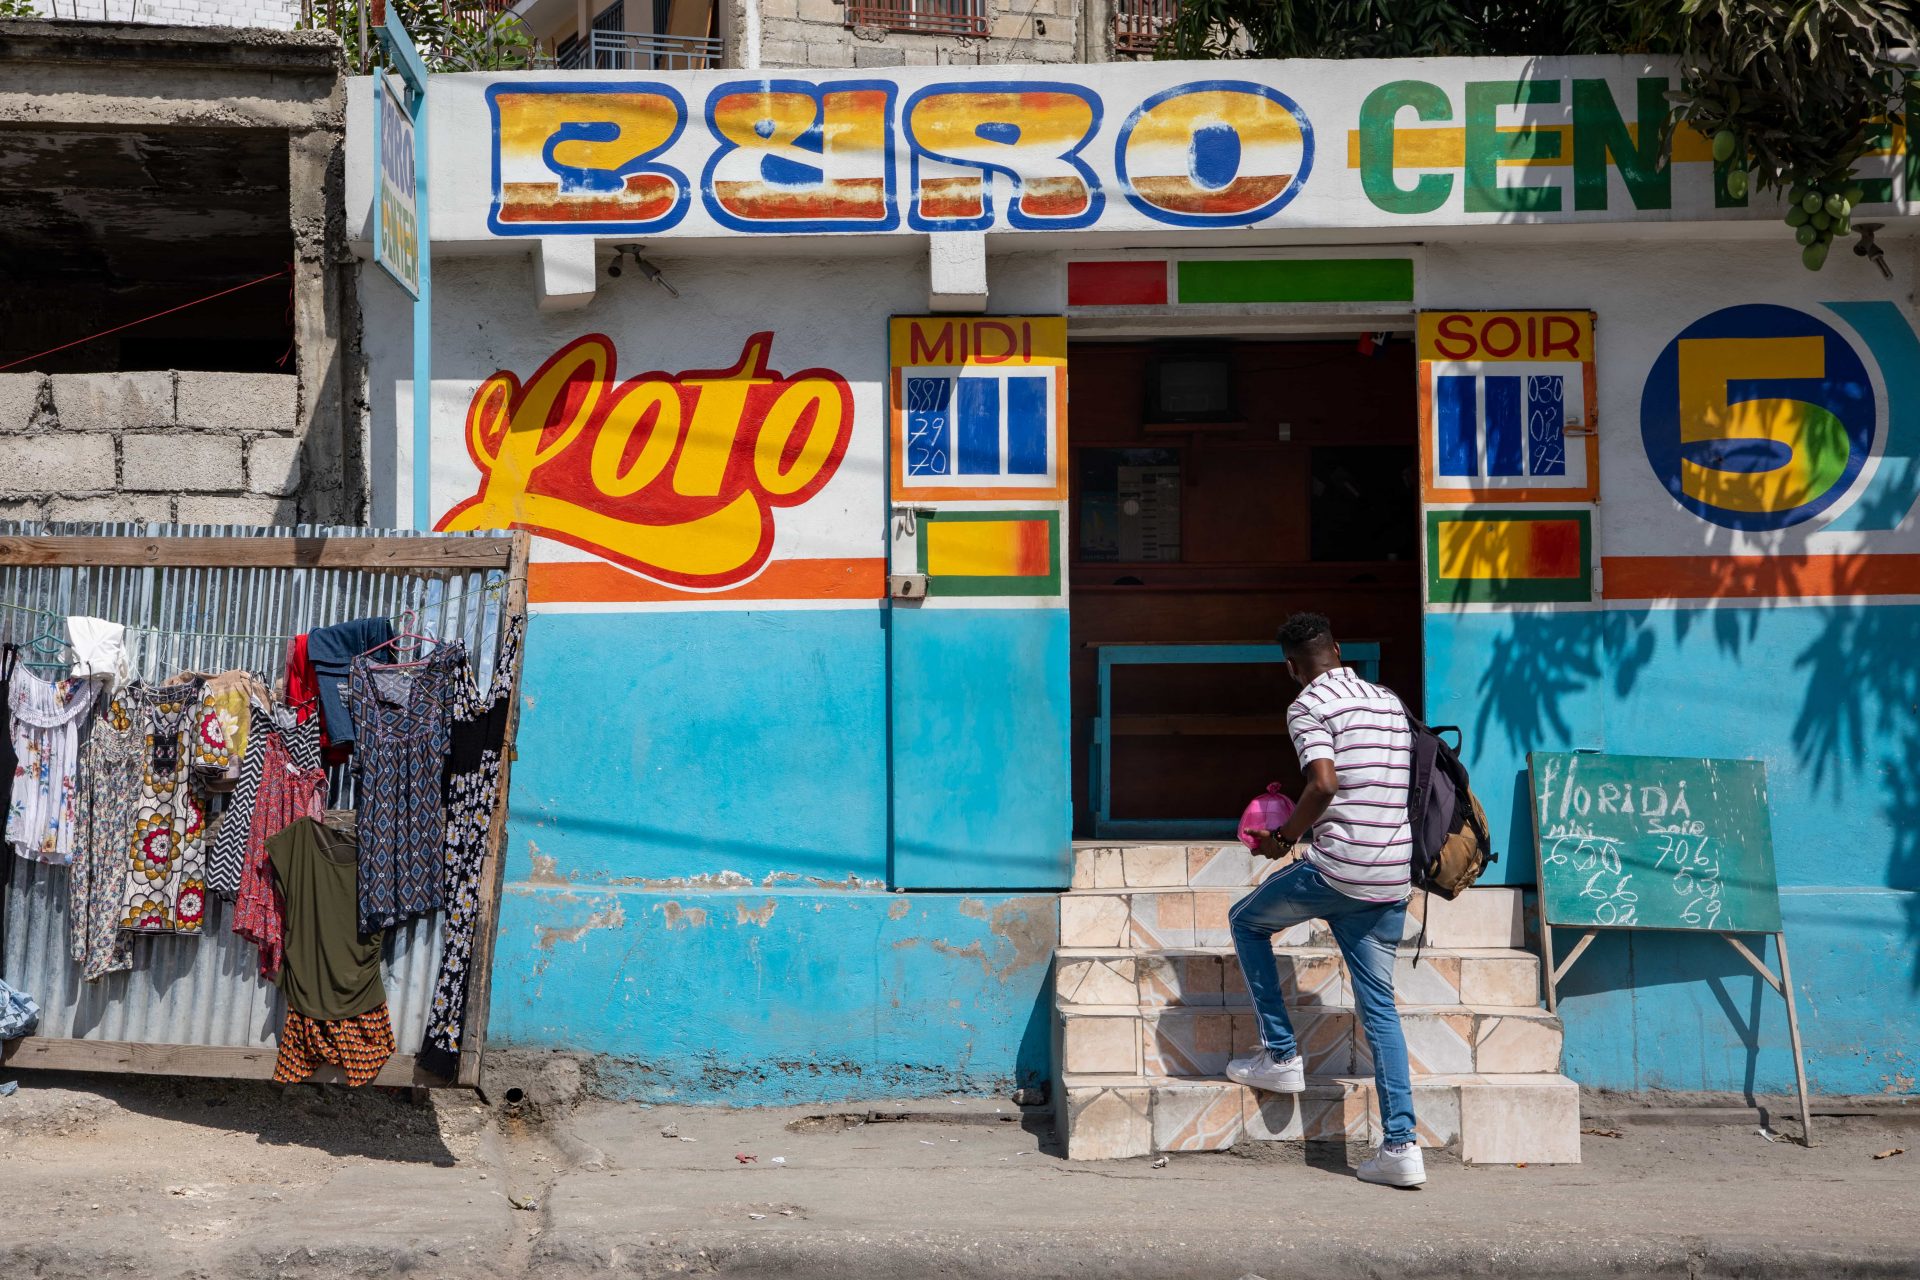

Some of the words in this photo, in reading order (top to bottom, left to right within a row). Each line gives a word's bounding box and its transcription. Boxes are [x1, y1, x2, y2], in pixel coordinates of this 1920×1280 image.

[910, 321, 1031, 364] MIDI
[1434, 315, 1581, 360] SOIR
[909, 379, 944, 413] 881
[1528, 376, 1564, 403] 030
[908, 417, 944, 447] 79
[1678, 336, 1850, 513] 5
[433, 330, 854, 588] Loto
[911, 447, 946, 476] 70
[1533, 443, 1565, 473] 97
[1544, 837, 1623, 876] 650
[1654, 836, 1710, 868] 706
[1579, 870, 1639, 902] 66
[1672, 863, 1721, 899] 53
[1595, 901, 1639, 926] 02
[1679, 897, 1723, 930] 69
